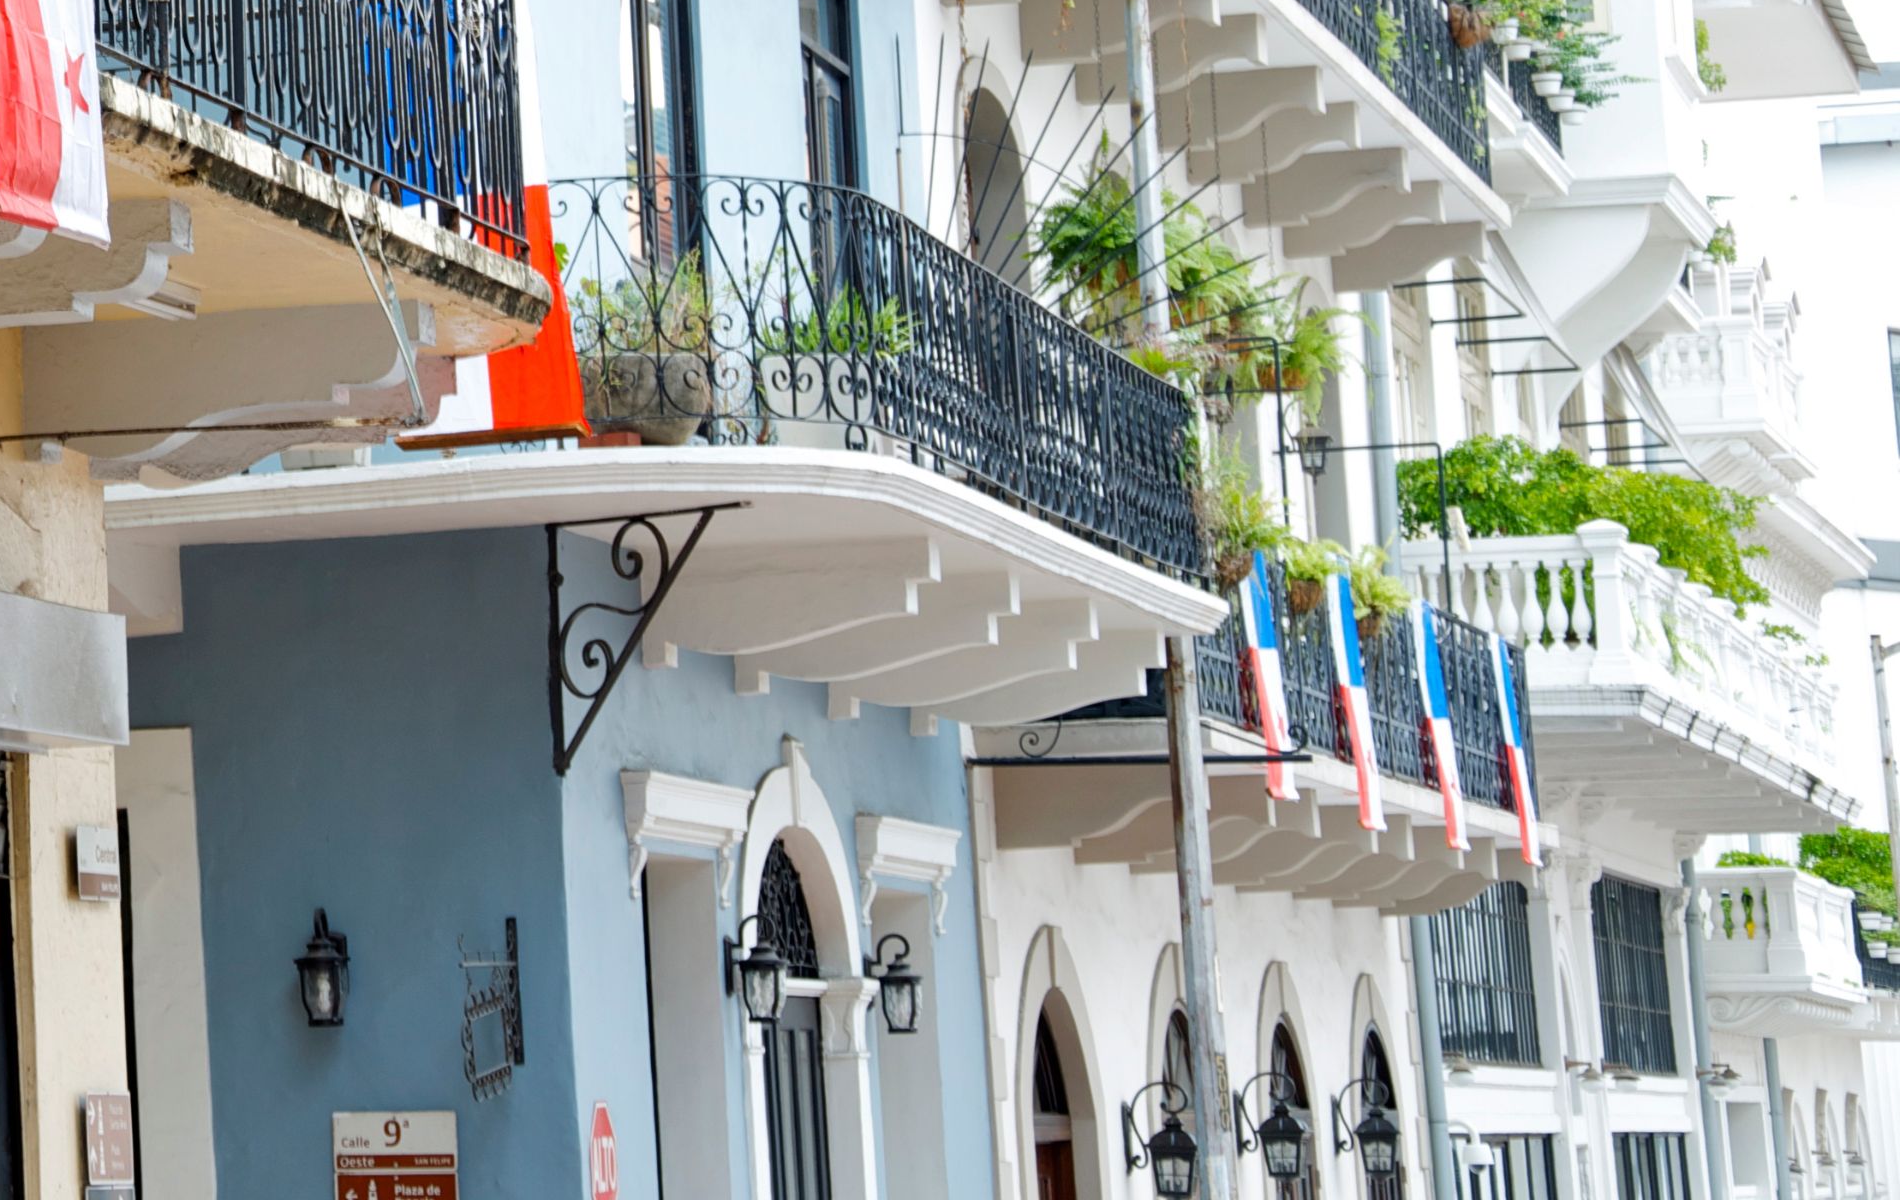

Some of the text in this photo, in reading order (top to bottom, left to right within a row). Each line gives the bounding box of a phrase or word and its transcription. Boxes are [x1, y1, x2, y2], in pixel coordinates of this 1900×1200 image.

[341, 1136, 370, 1148] Calle
[340, 1156, 375, 1168] Oeste
[592, 1136, 618, 1195] ALTO
[394, 1184, 441, 1196] Plaza de
